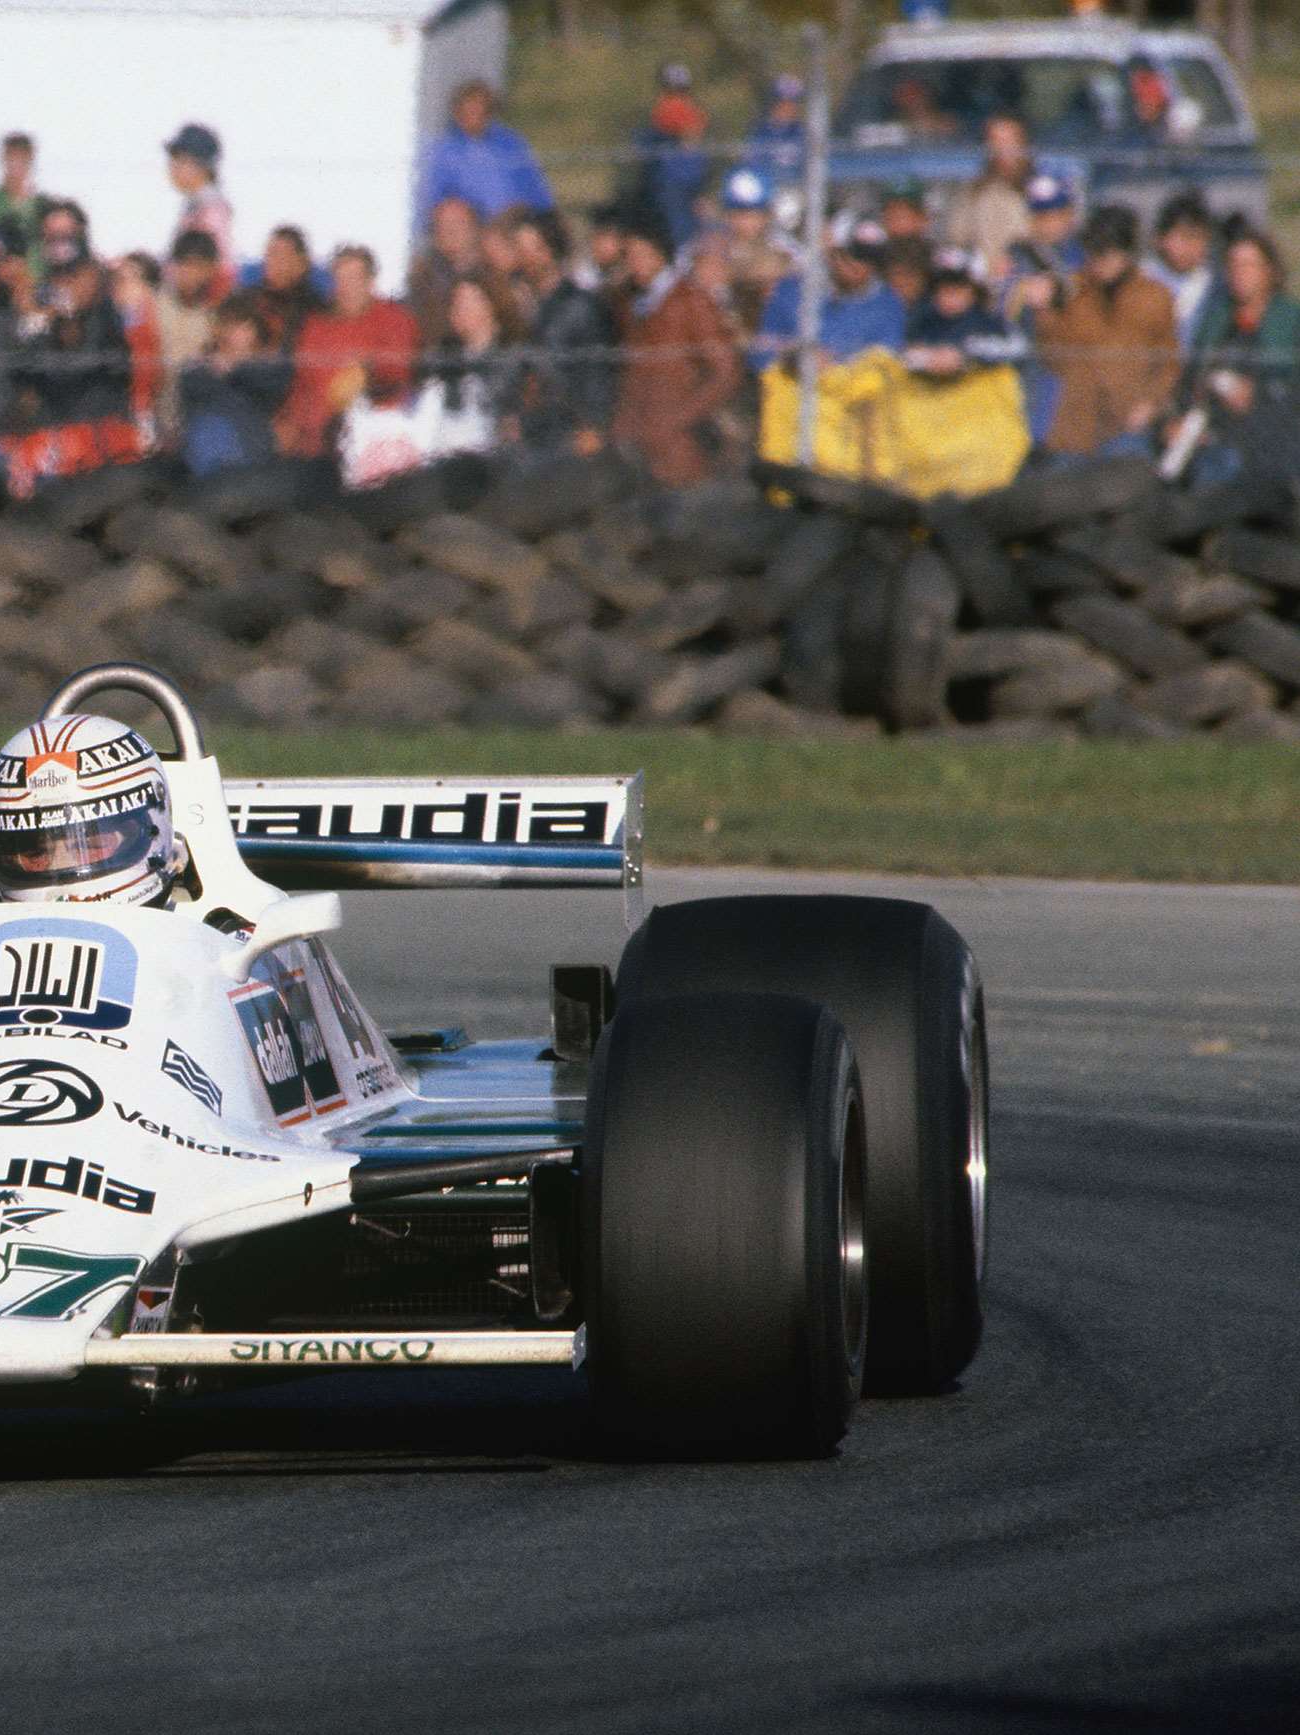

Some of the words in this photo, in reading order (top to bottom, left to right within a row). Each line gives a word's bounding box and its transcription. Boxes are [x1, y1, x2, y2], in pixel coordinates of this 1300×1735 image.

[78, 737, 142, 776] AKAI
[67, 799, 120, 824] AKAI
[2, 1083, 52, 1103] L
[112, 1100, 282, 1162] Vehicles
[229, 1338, 435, 1362] SIYANCO
